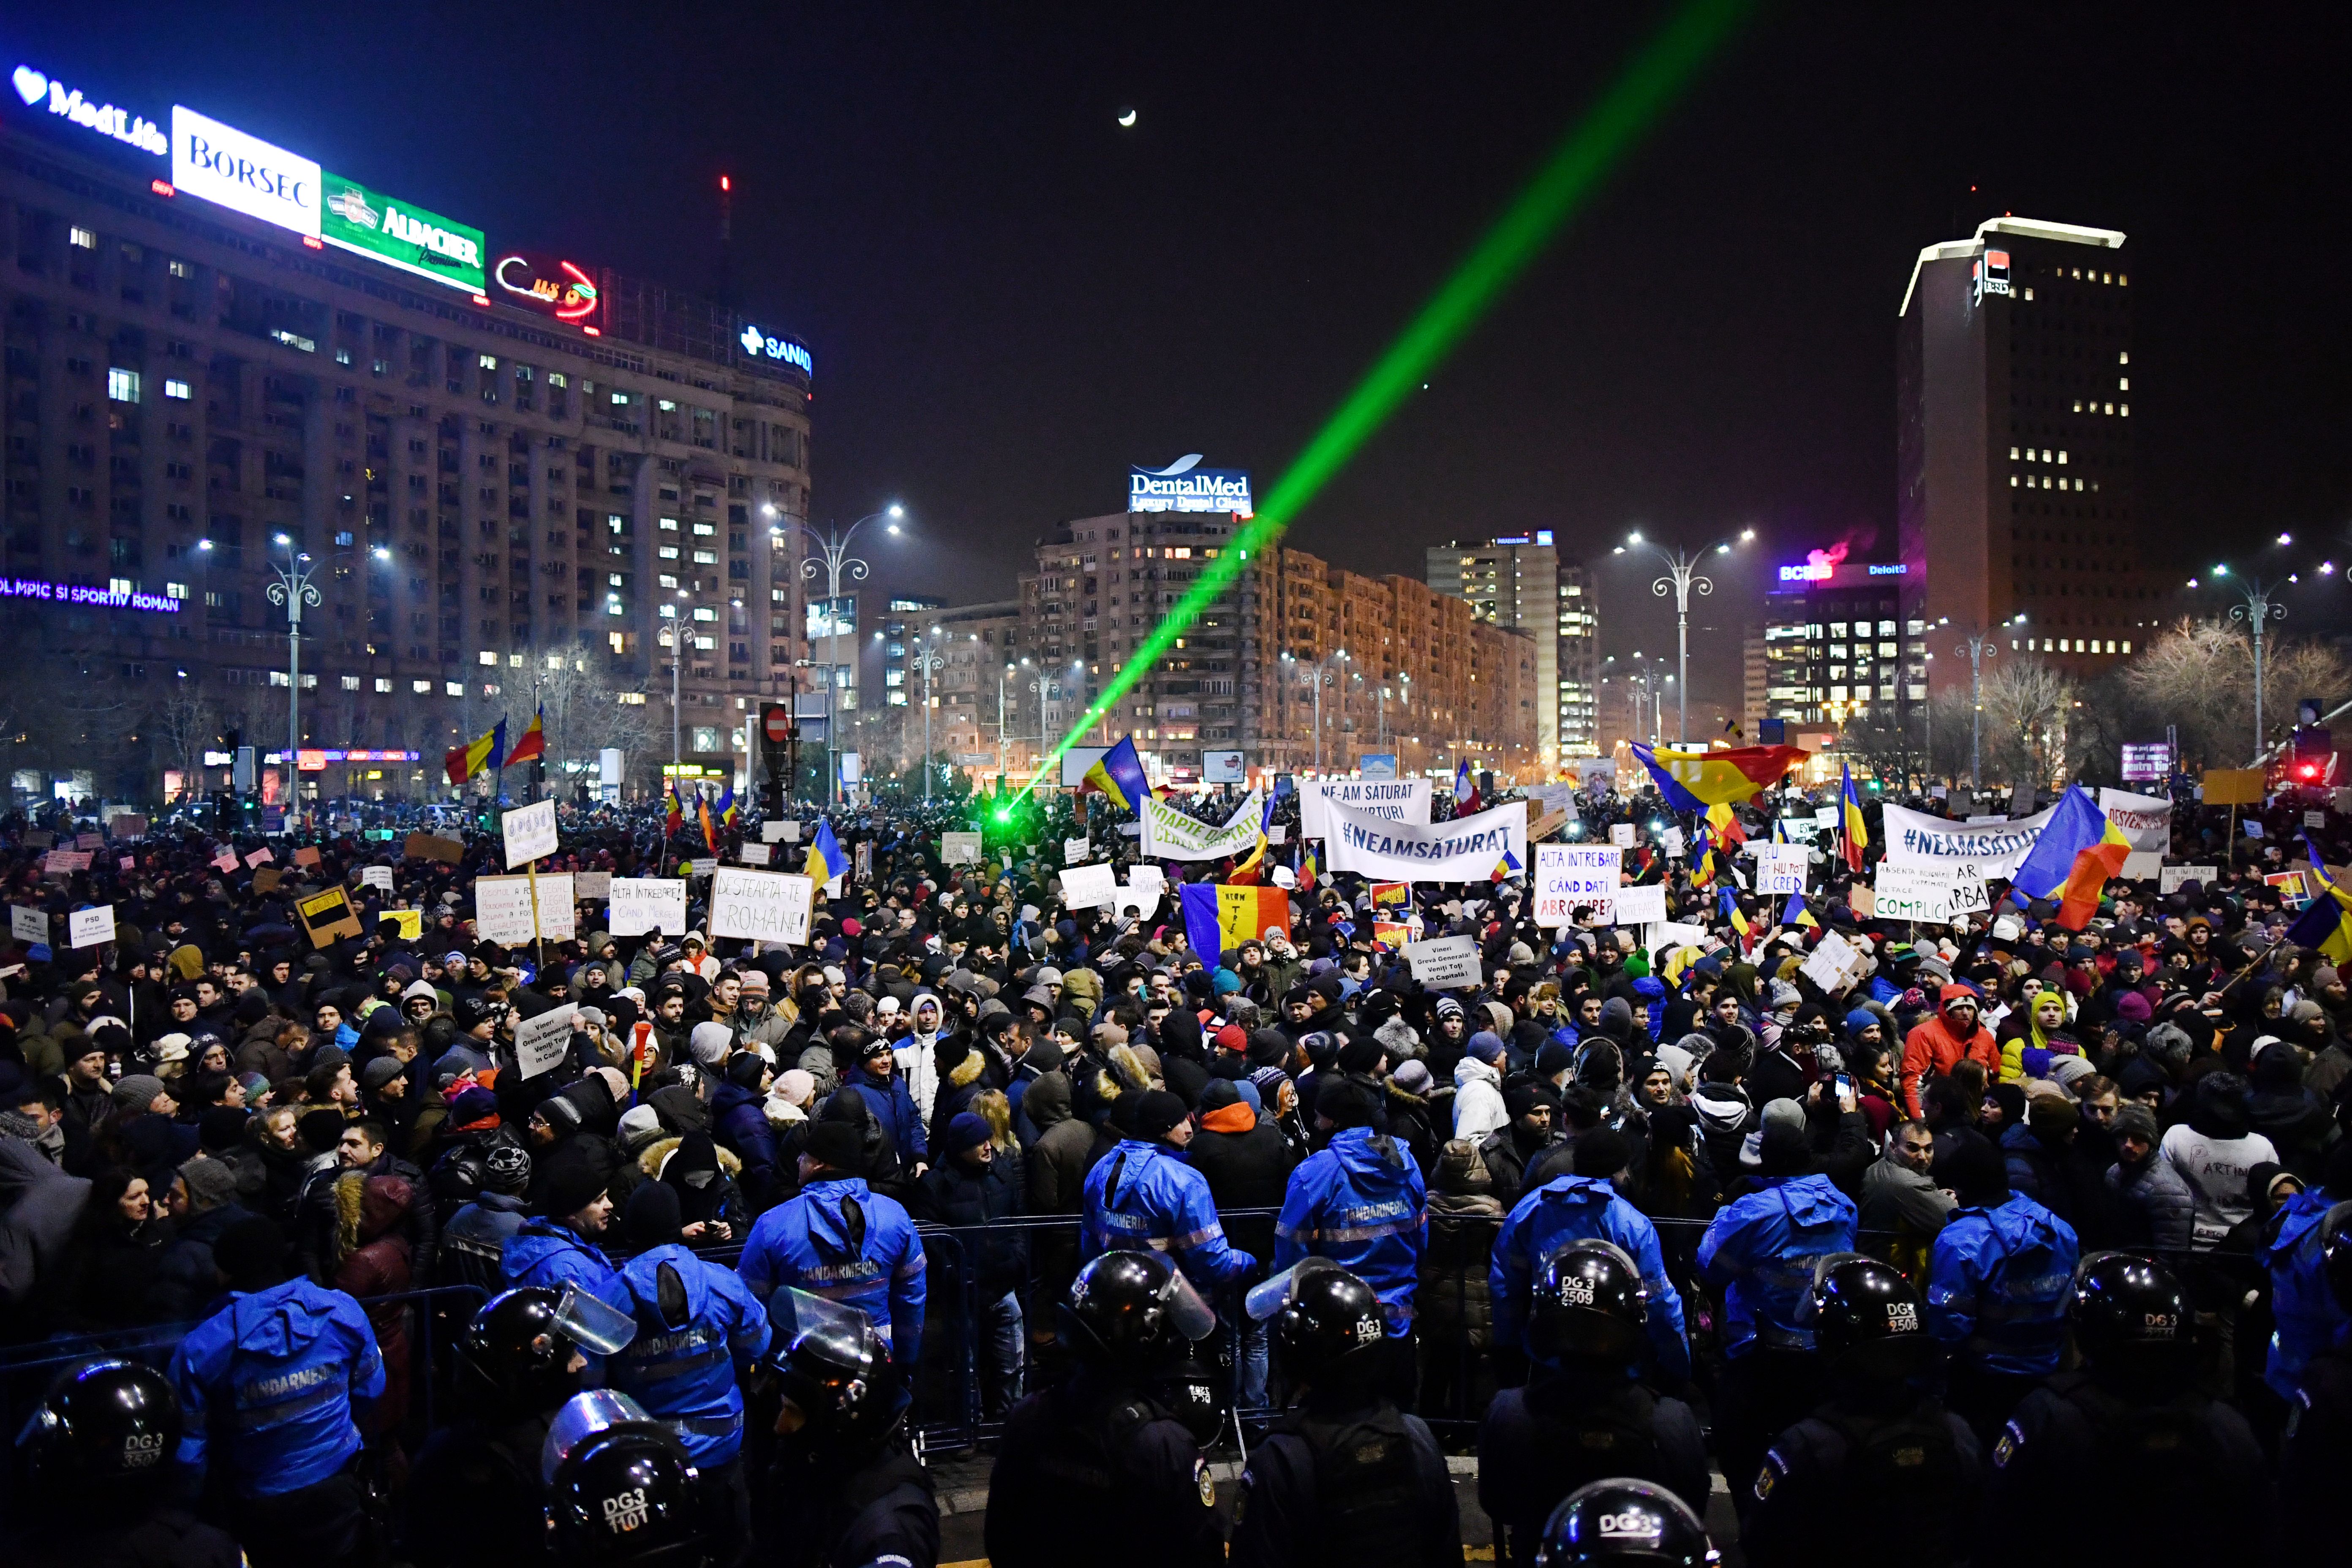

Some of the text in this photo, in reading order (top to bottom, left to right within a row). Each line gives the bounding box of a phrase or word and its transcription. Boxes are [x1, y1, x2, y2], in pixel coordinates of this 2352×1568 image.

[50, 80, 168, 155] MedLife
[191, 134, 309, 208] BORSEC
[766, 337, 812, 379] SANAD
[1131, 474, 1249, 497] DentalMed
[1132, 495, 1249, 509] Luxury Dental Clinic
[1781, 566, 1815, 581] BCR
[0, 577, 52, 600] OLMPIC
[72, 585, 129, 607] SPORTIV
[133, 594, 180, 612] ROMAN
[1321, 781, 1413, 801] NE-AM SĂTURAT
[1149, 801, 1205, 837] NOAPTE
[1356, 806, 1404, 820] RTURI
[1342, 822, 1511, 859] #NEAMSĂTURAT
[1903, 827, 2043, 856] #NEAMSĂTUR
[1540, 848, 1565, 867] ALTĂ
[1765, 846, 1778, 859] EU
[1759, 863, 1805, 874] TOT NU POT
[542, 882, 568, 894] LEGAL
[1549, 877, 1608, 896] CÂND DAȚI
[1773, 877, 1802, 890] CRED
[1911, 879, 1948, 888] EXPRIMATE
[544, 894, 570, 906] LEGAL
[1079, 887, 1111, 902] LACHE
[1876, 897, 1946, 919] COMPLICI
[85, 915, 100, 924] PSD
[635, 921, 644, 930] LA
[727, 904, 804, 936] ROMÂNE!
[540, 925, 574, 936] REPTATE
[1228, 906, 1240, 950] TREZI
[1432, 945, 1452, 953] Vineri
[1417, 952, 1471, 965] Grevă Generală!
[535, 1018, 554, 1030] Vineri
[523, 1035, 542, 1047] Grevă
[543, 1048, 563, 1060] Capita
[1104, 1211, 1149, 1230] DARMERIA
[1562, 1290, 1594, 1305] 2509
[1889, 1318, 1918, 1332] 2506
[608, 1507, 648, 1534] 1101
